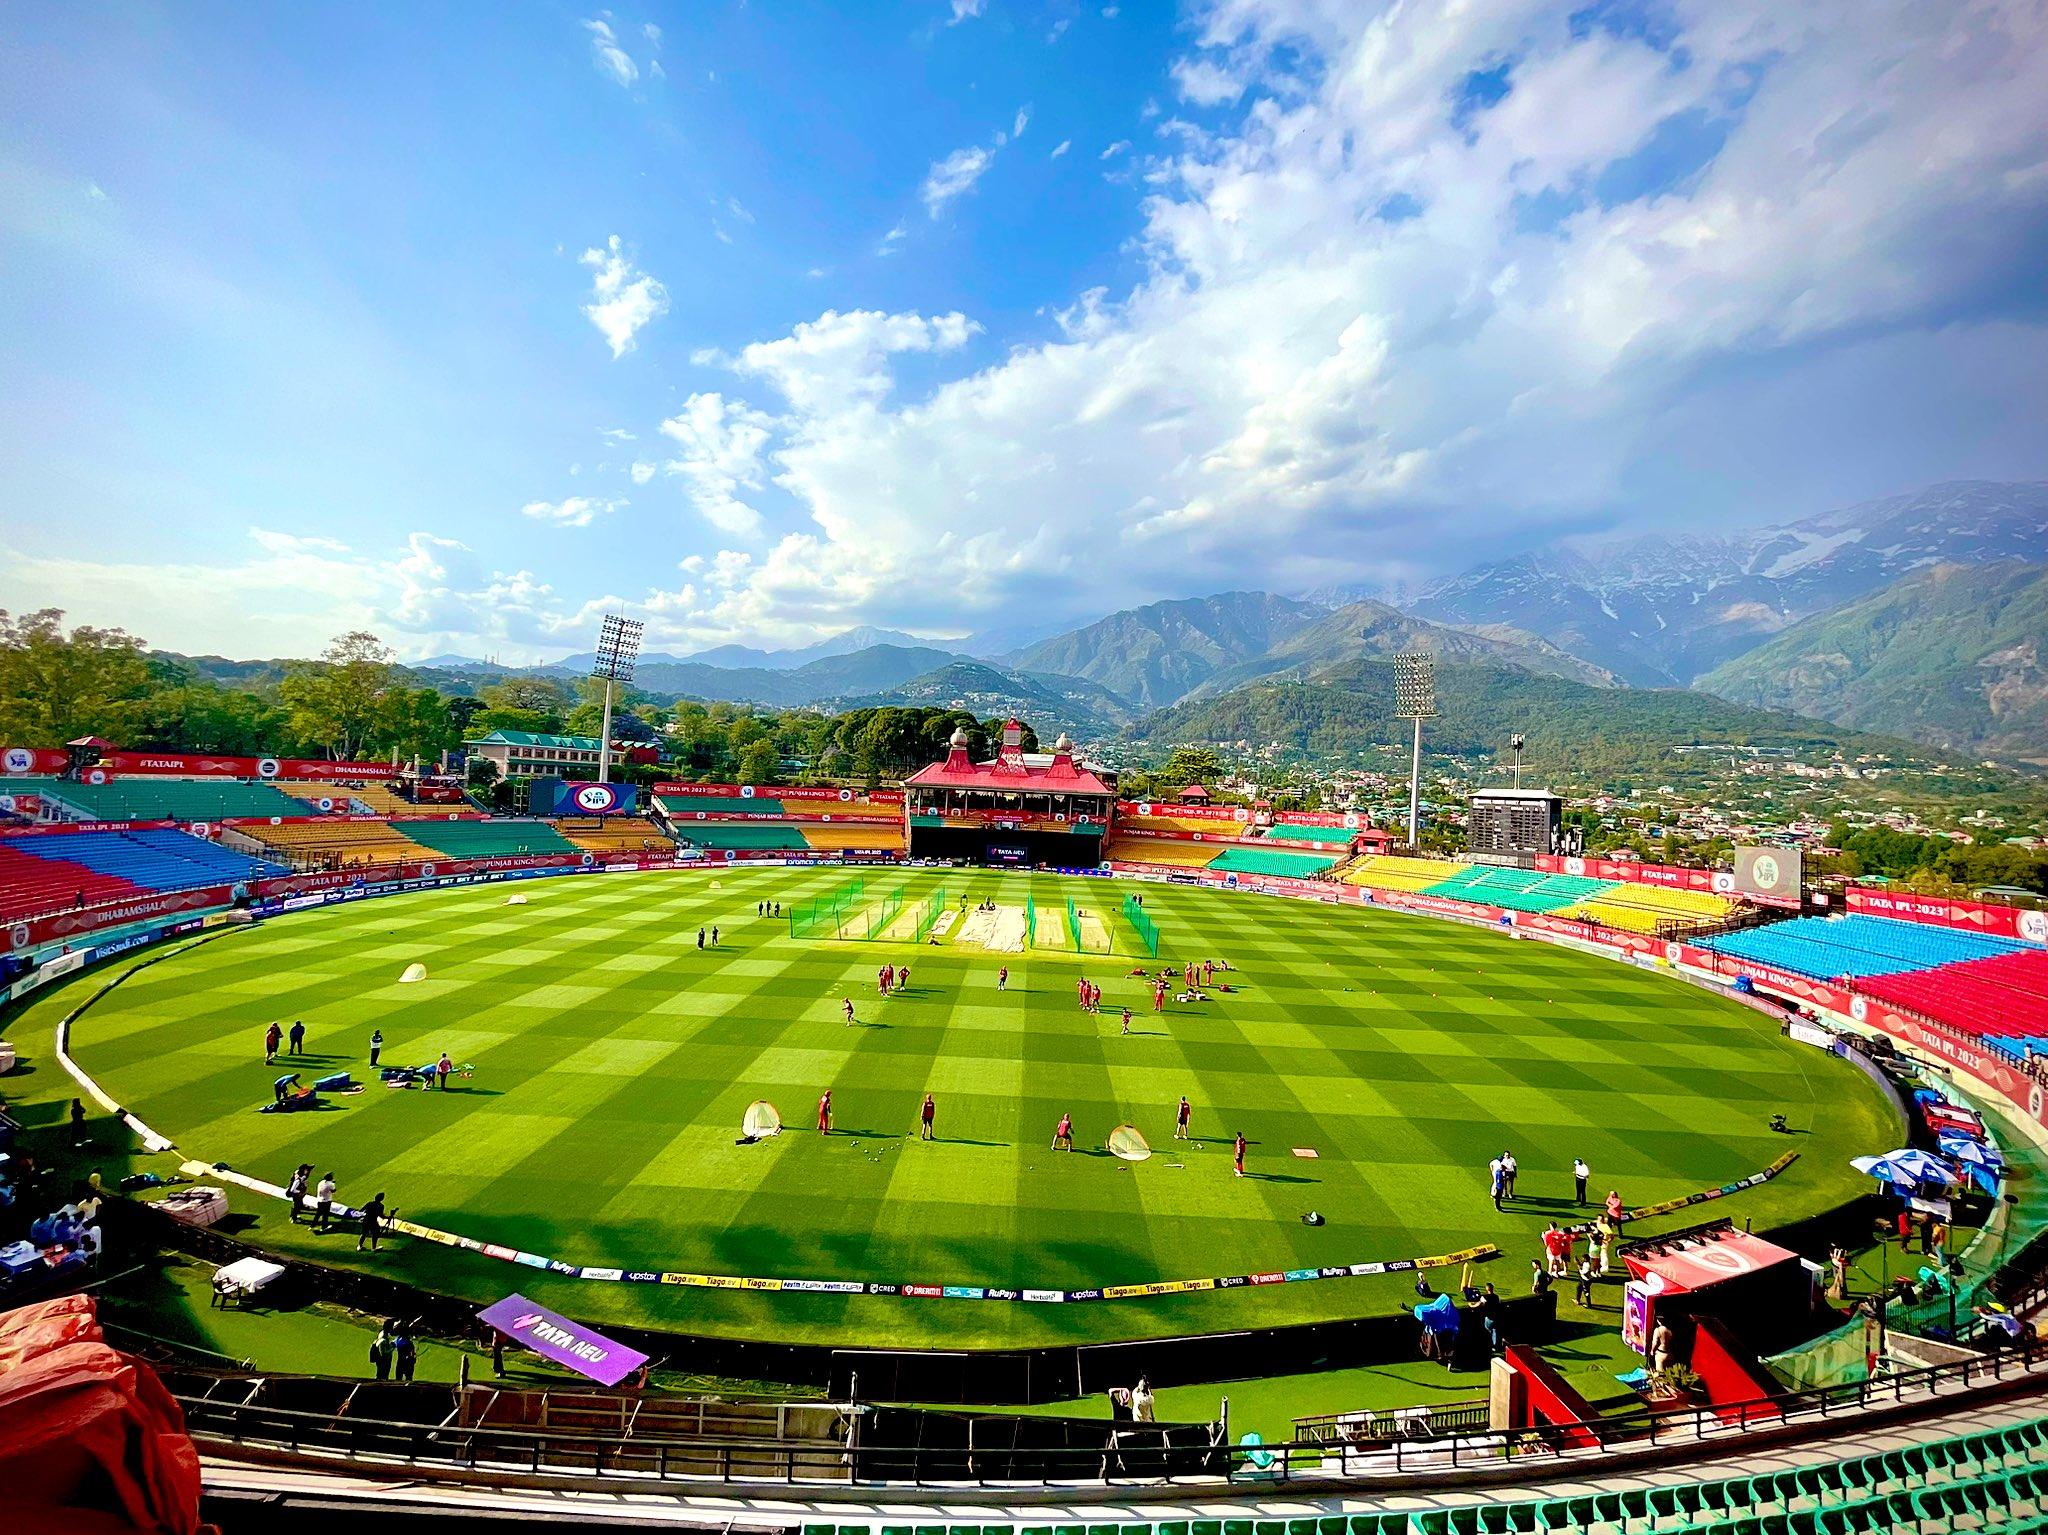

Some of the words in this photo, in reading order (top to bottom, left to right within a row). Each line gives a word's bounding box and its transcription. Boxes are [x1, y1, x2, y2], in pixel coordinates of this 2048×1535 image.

[140, 760, 184, 769] #TATAIPL
[486, 860, 512, 868] PUNJAB
[514, 858, 535, 866] KINGS
[310, 877, 330, 886] TATA
[346, 873, 367, 882] 2023
[97, 901, 167, 923] DHARAMSHALA
[1869, 897, 1893, 909] TATA
[1895, 901, 1913, 912] IPL
[1916, 904, 1945, 916] 2023
[95, 935, 149, 958] VisitSaudi.com
[1736, 963, 1767, 980] PUNJAB
[1768, 970, 1795, 987] KINGS
[1922, 1029, 1941, 1051] TATA
[1942, 1039, 1956, 1059] IPL
[1956, 1047, 1980, 1070] 2023
[550, 1261, 572, 1275] RuPay
[1389, 1261, 1412, 1270] upstox
[628, 1272, 657, 1282] upstox
[1323, 1267, 1343, 1277] RuPay
[1228, 1277, 1244, 1285] CRED
[988, 1289, 1015, 1299] RuPay
[1070, 1289, 1098, 1300] upstox
[531, 1322, 574, 1349] TATA
[570, 1340, 609, 1363] NEU
